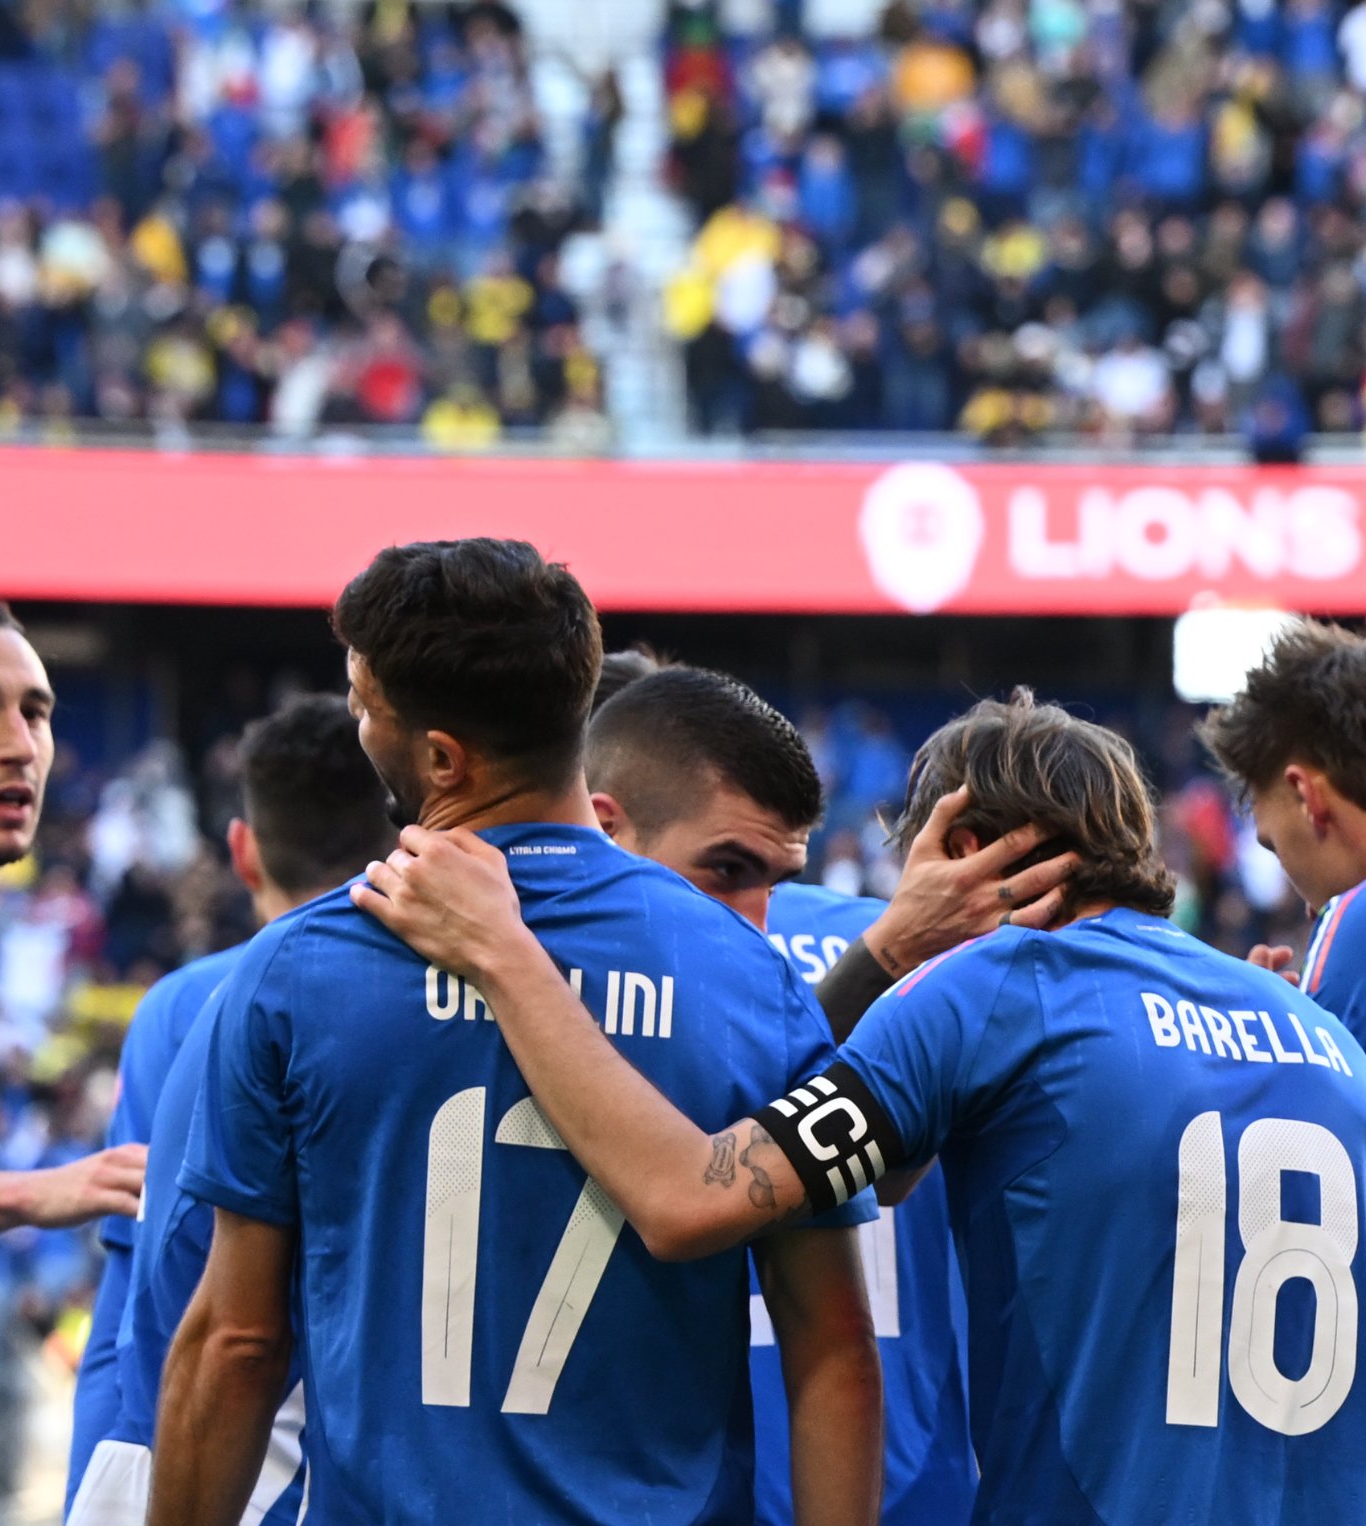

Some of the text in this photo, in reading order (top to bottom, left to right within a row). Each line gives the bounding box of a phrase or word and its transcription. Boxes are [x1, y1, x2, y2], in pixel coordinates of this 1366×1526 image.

[1008, 484, 1362, 580] LIONS
[1139, 991, 1354, 1078] BARELLA
[421, 1086, 628, 1416] 17
[1165, 1110, 1359, 1437] 18
